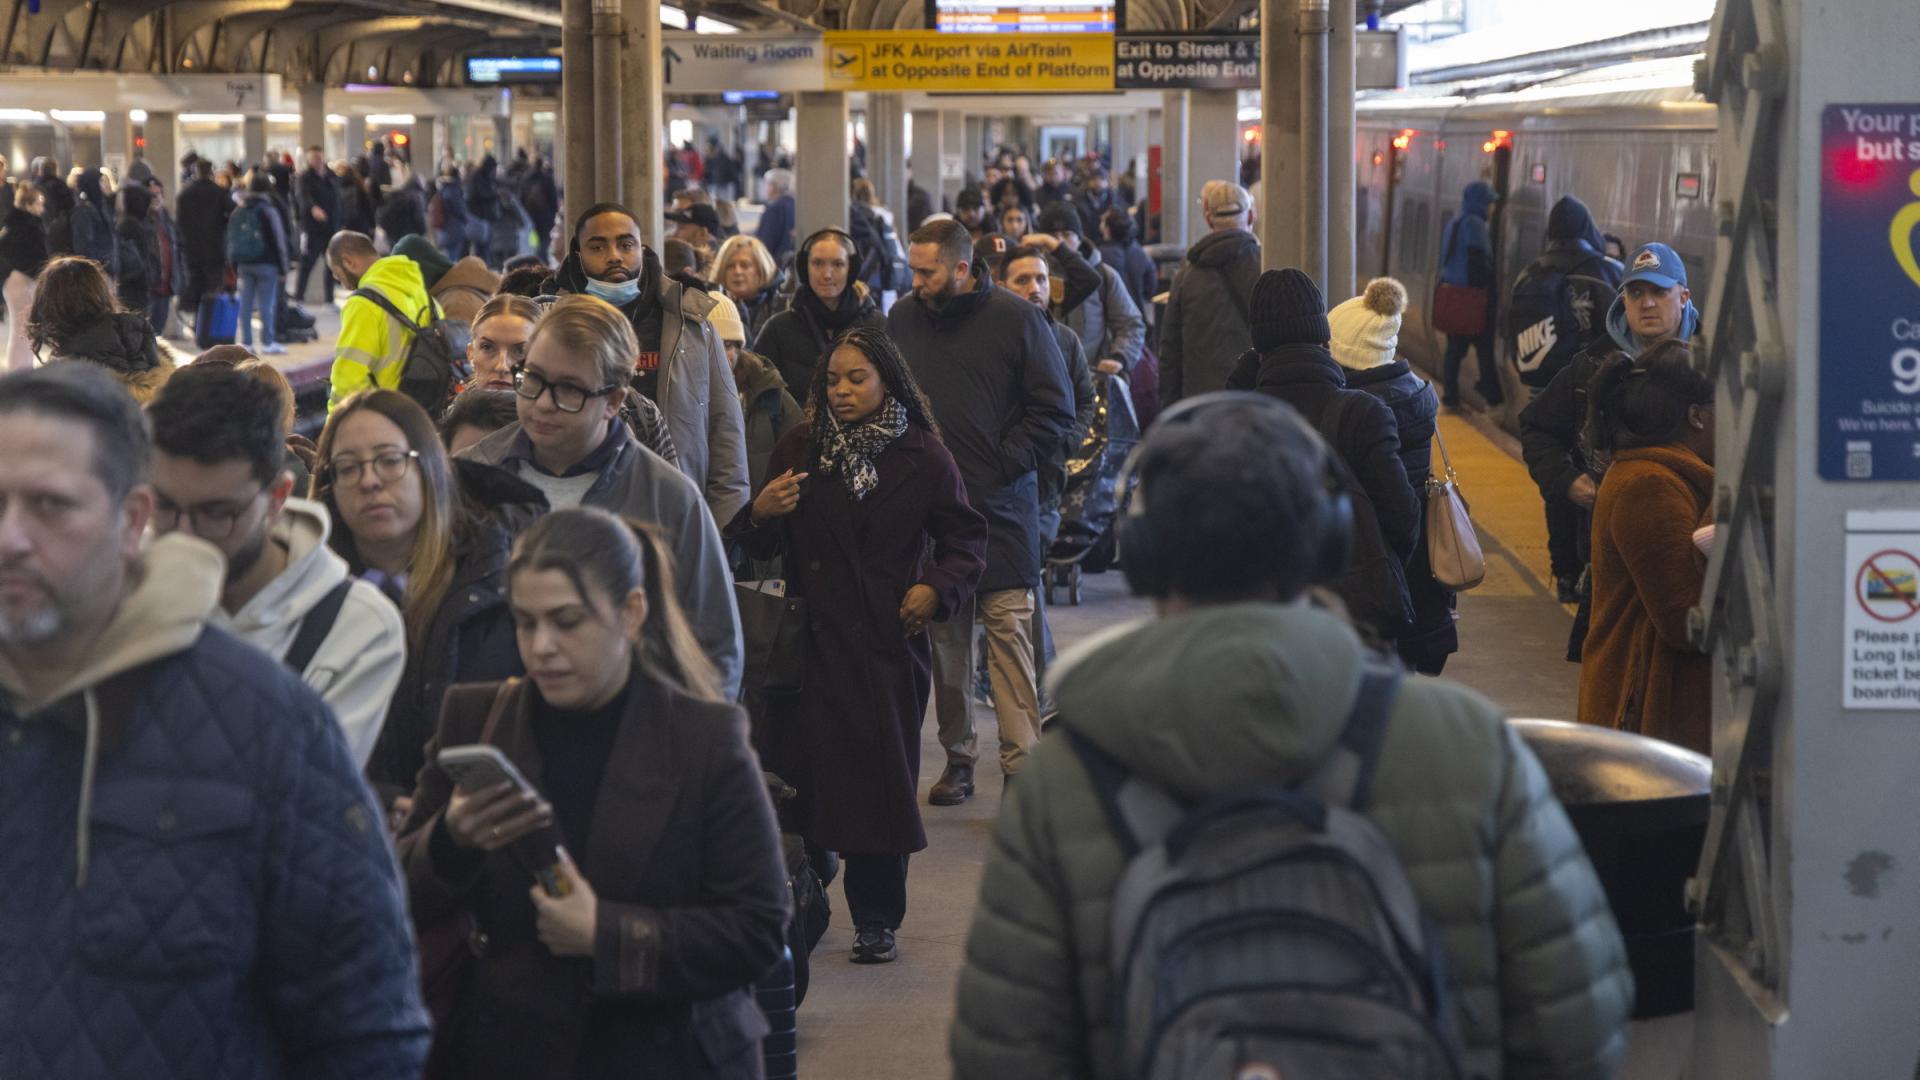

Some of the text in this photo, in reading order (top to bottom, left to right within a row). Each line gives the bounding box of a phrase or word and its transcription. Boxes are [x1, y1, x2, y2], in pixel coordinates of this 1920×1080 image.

[693, 43, 814, 62] Waiting Room
[871, 43, 1072, 61] JFK Airport via AirTrain
[1117, 41, 1151, 58] Exit
[1155, 43, 1173, 58] to
[1178, 41, 1230, 58] Street
[1234, 42, 1248, 58] &
[871, 62, 1110, 80] at Opposite End of Platform
[1117, 61, 1257, 80] at Opposite End
[1841, 109, 1905, 132] Your
[1857, 136, 1904, 160] but
[1517, 316, 1557, 360] NIKE
[1862, 400, 1911, 414] Suicide
[1854, 629, 1909, 643] Please
[1854, 649, 1896, 664] Long
[1853, 666, 1898, 680] ticket
